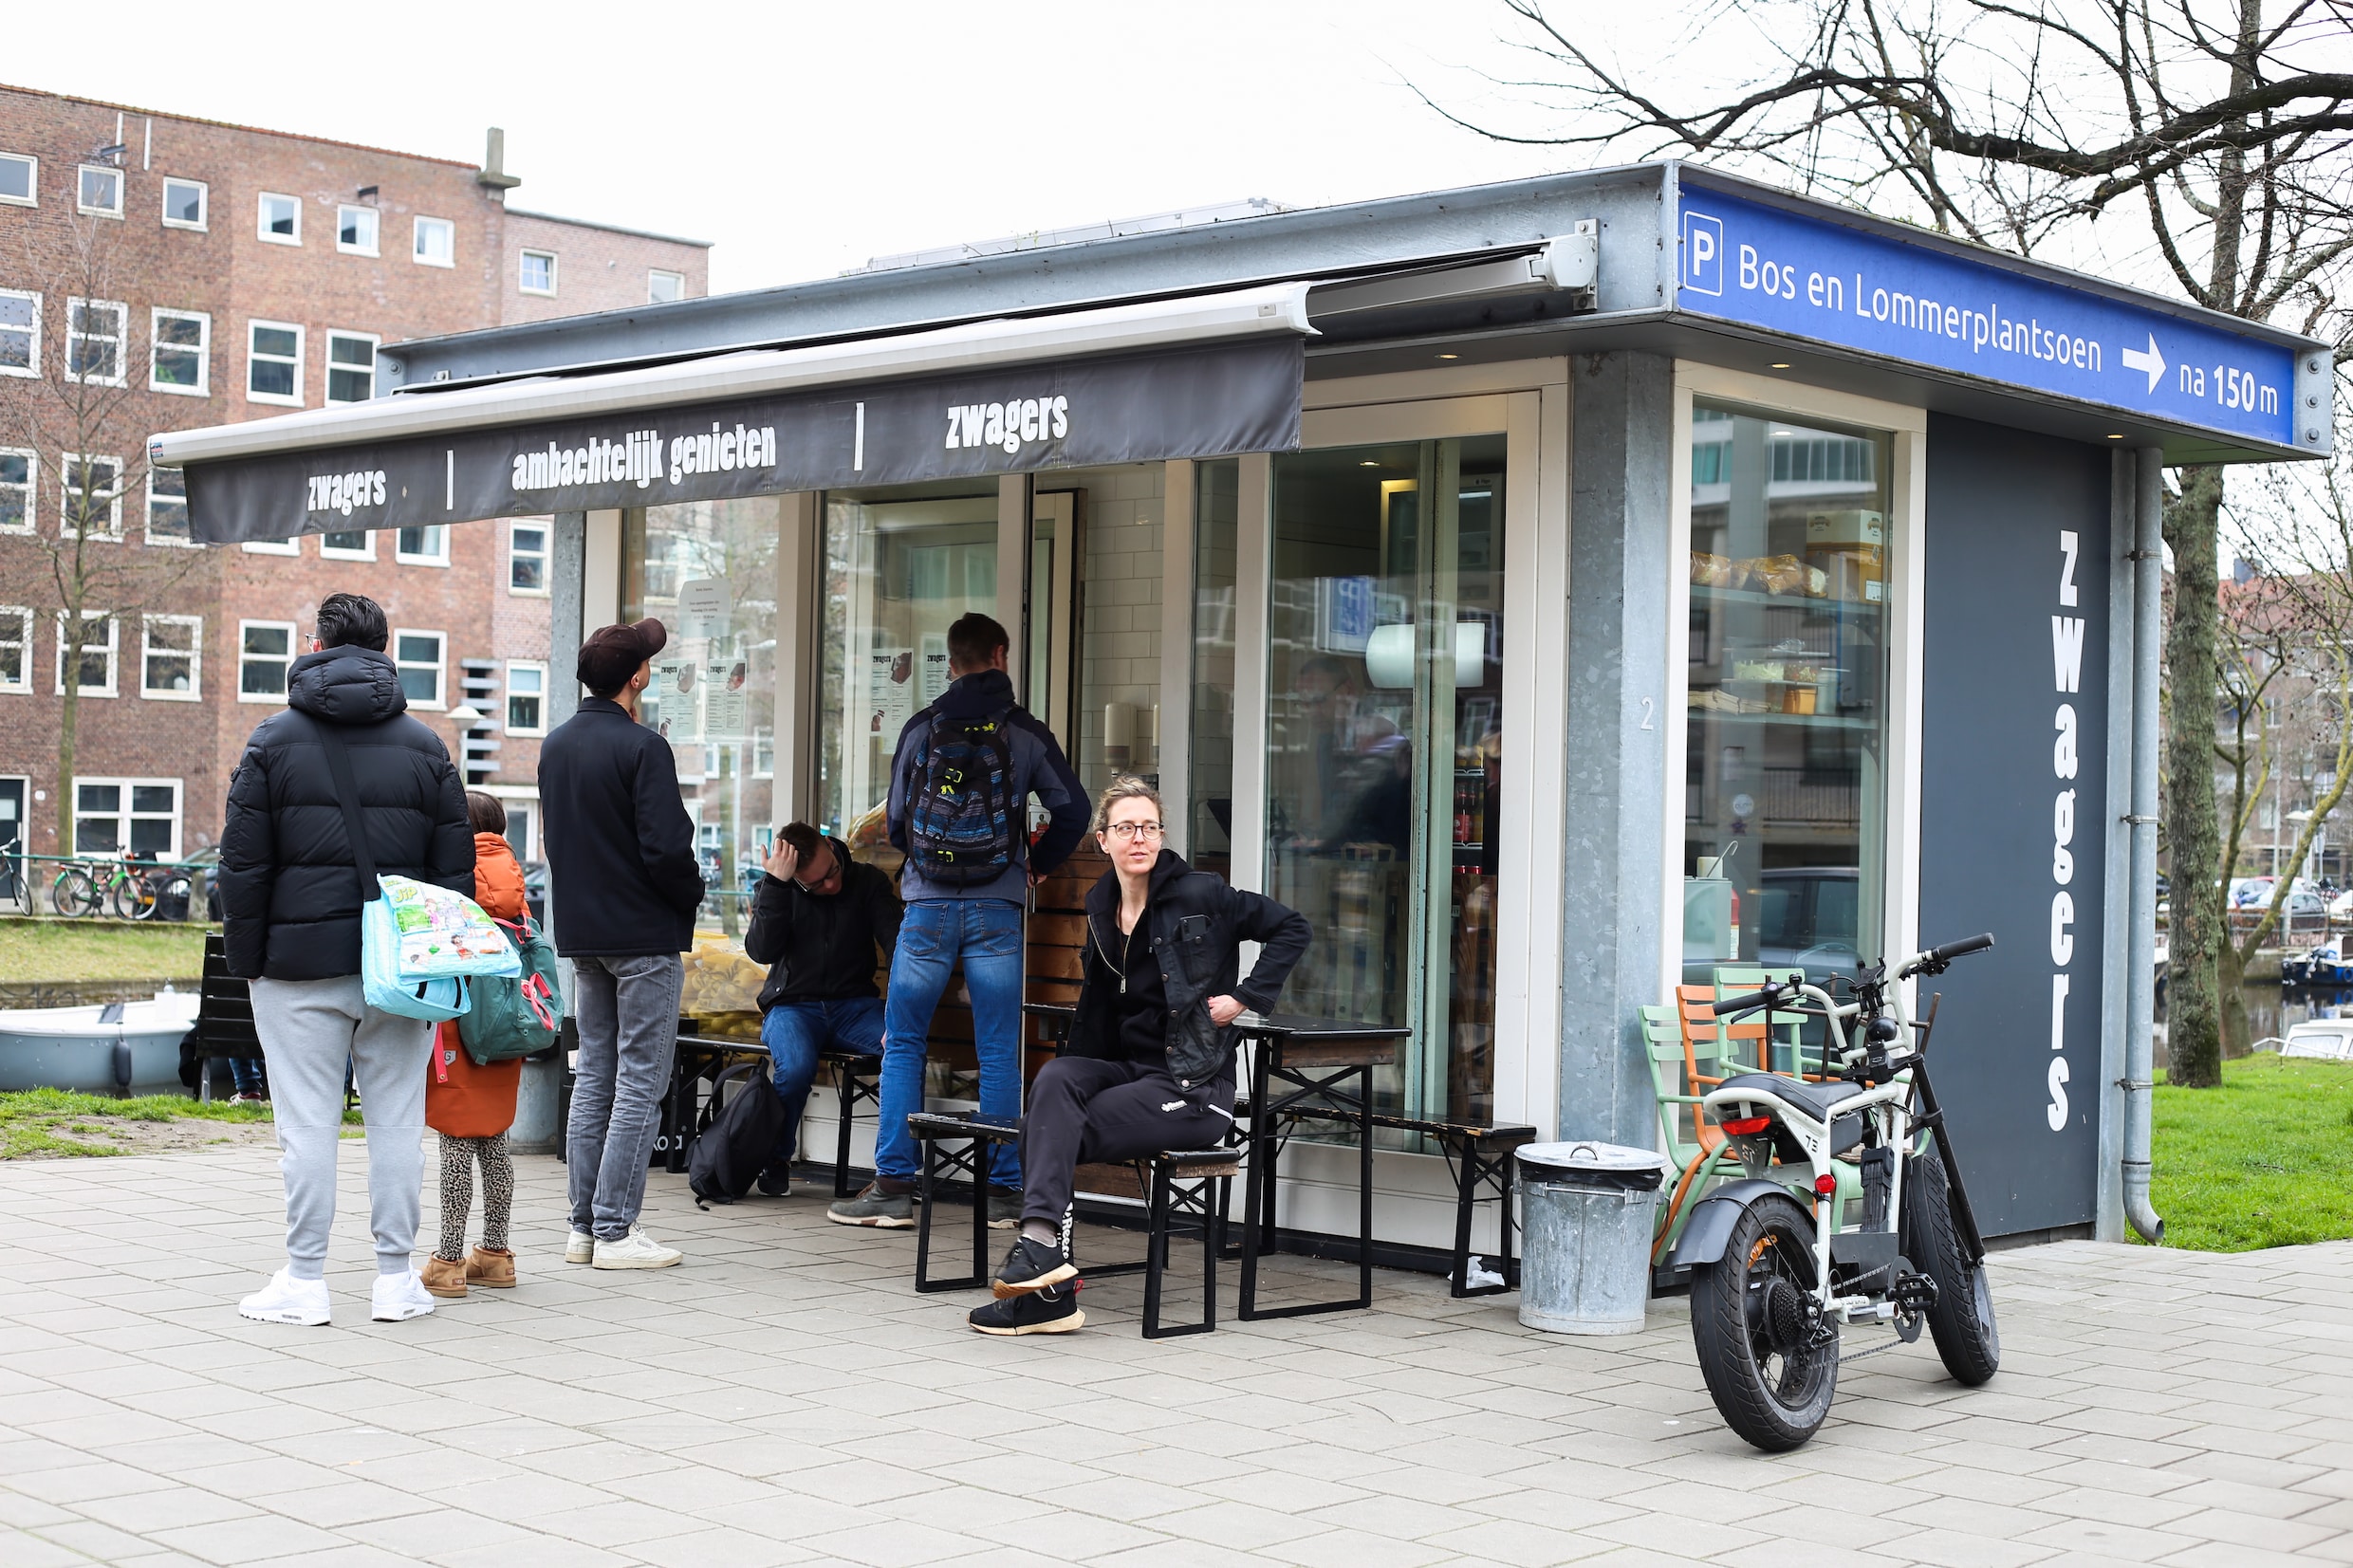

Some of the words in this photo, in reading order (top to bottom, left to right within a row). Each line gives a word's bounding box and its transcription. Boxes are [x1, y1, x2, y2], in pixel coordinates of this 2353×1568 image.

[1694, 230, 1715, 276] P
[1740, 244, 1796, 300] Bos
[1808, 271, 1843, 312] en
[1857, 273, 2102, 372] Lommerplantsoen
[2180, 364, 2205, 397] na
[2214, 365, 2255, 412] 150
[2261, 386, 2278, 415] m
[946, 396, 1068, 453] zwagers
[512, 430, 664, 490] ambachtelijk
[670, 422, 777, 486] genieten
[308, 470, 387, 517] zwagers
[1640, 696, 1654, 730] 2
[2047, 529, 2085, 1132] zwagers
[1806, 1134, 1819, 1153] 73
